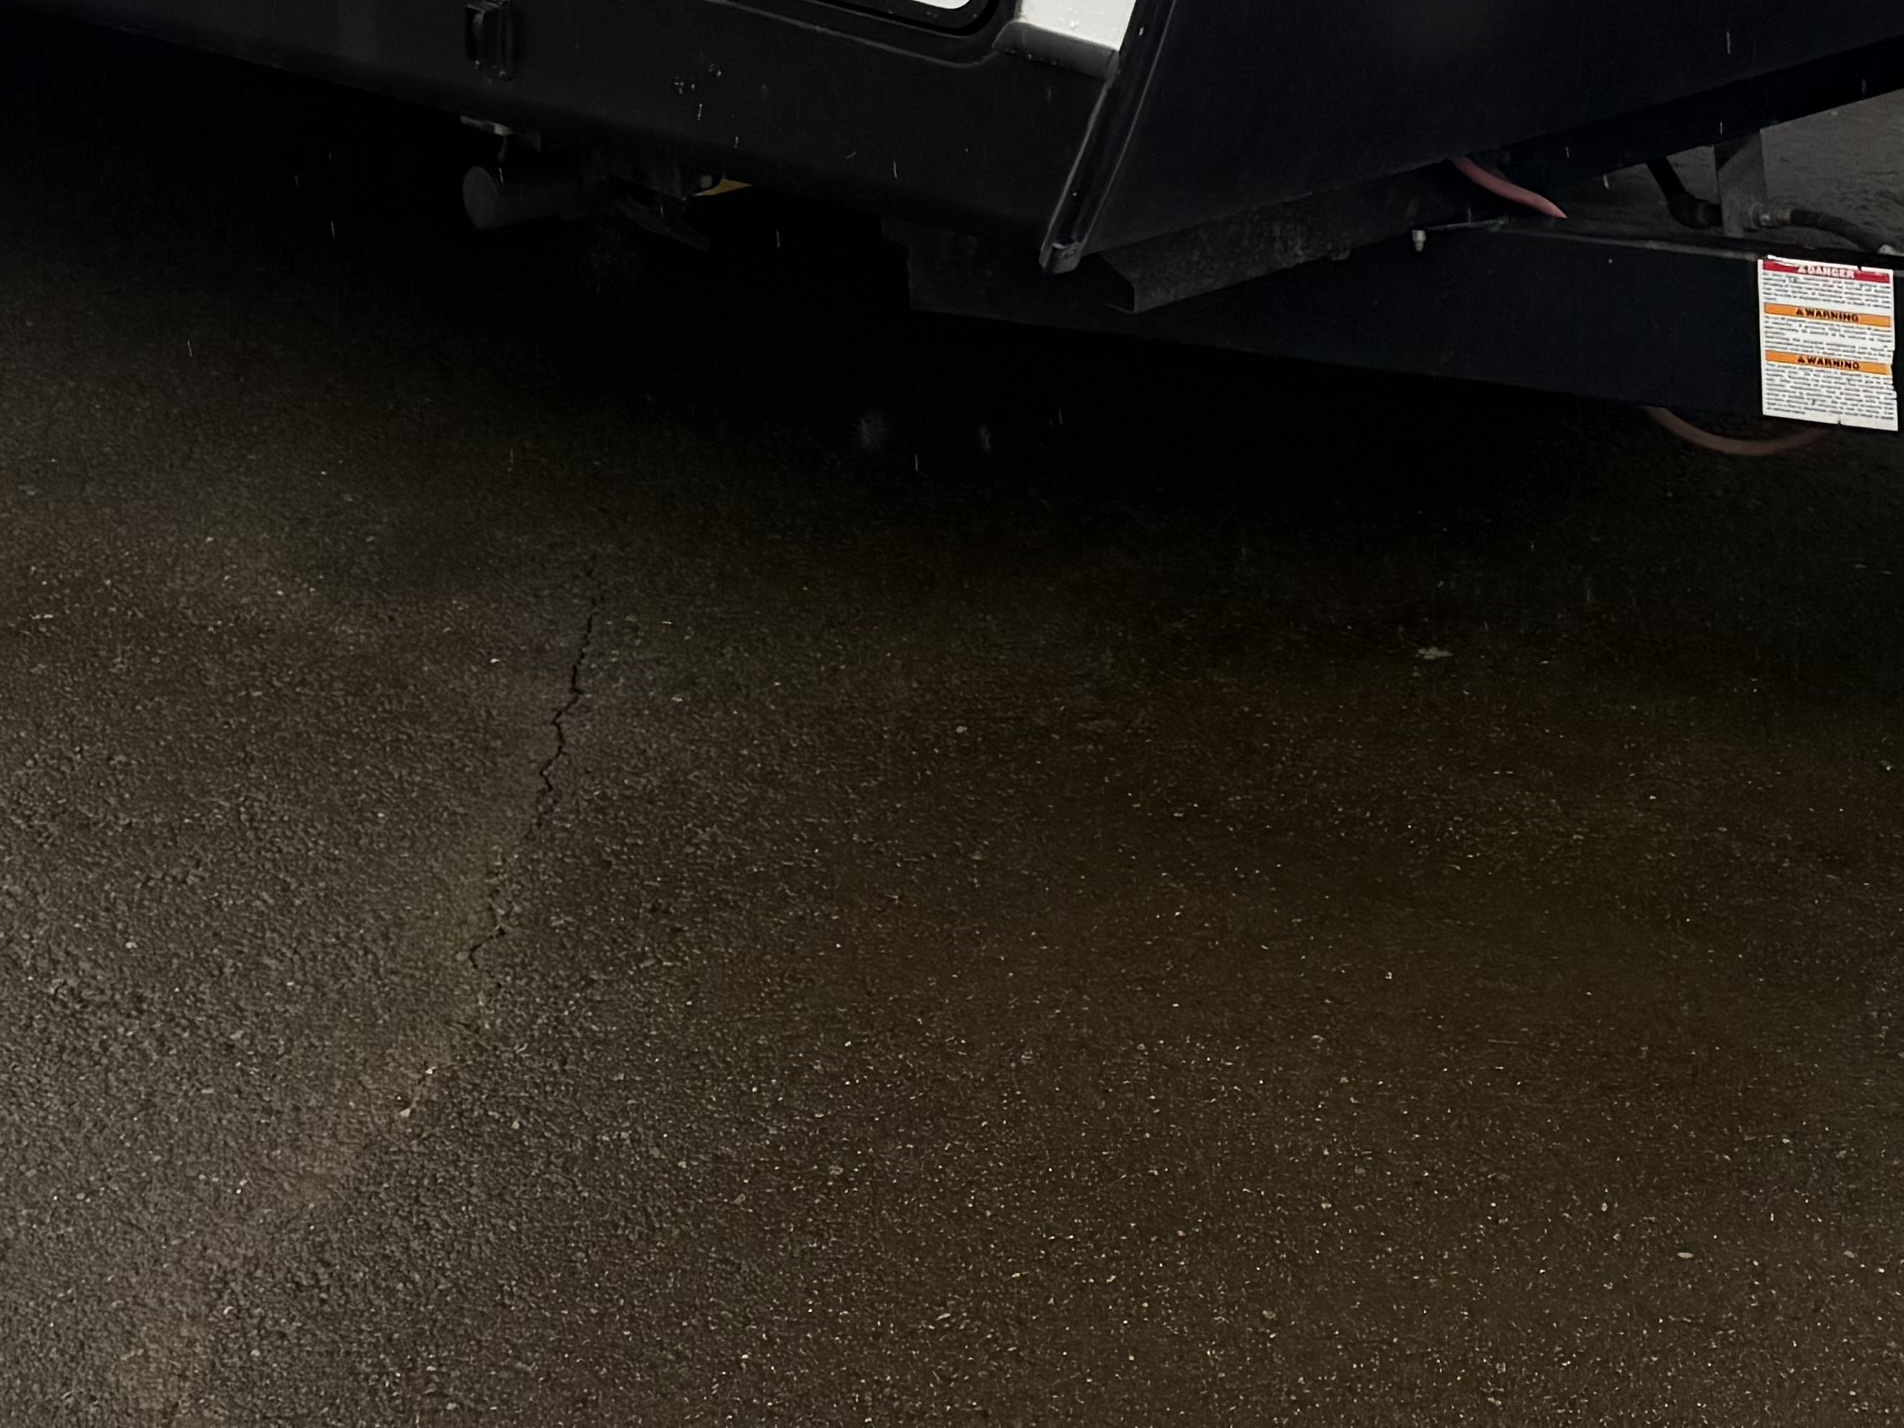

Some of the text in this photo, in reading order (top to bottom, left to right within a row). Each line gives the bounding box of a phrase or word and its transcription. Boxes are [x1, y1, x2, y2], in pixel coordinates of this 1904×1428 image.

[1808, 266, 1855, 278] DANGER
[1805, 307, 1859, 323] WARNING
[1807, 356, 1861, 370] WARNING
